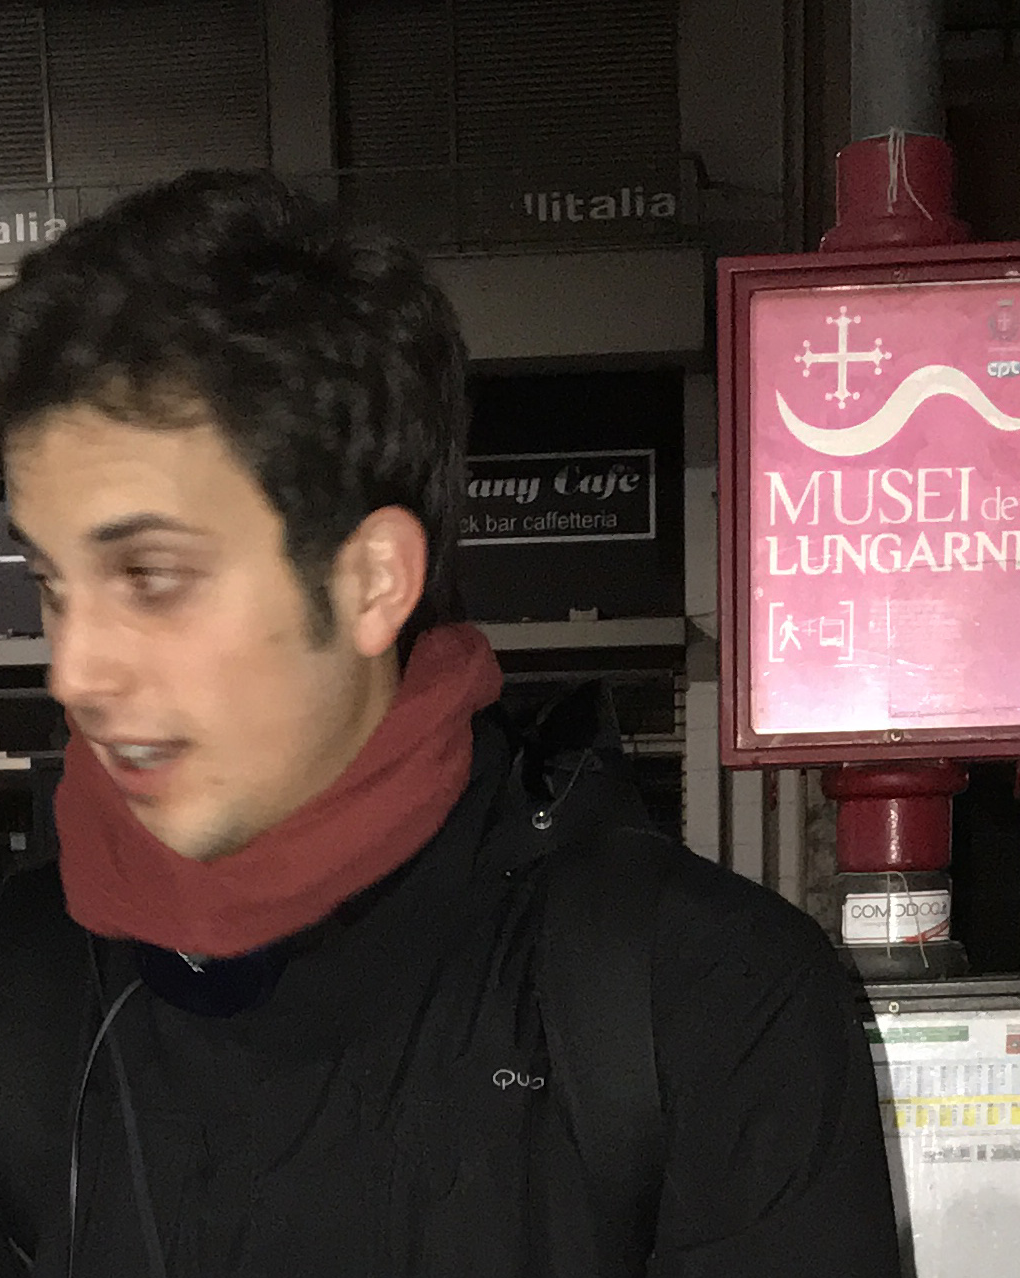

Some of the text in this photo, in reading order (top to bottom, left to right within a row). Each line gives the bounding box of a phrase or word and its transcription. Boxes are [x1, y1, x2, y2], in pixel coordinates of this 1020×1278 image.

[764, 467, 1019, 526] MUSEI de
[486, 513, 517, 533] bar
[523, 509, 618, 531] caffetteria
